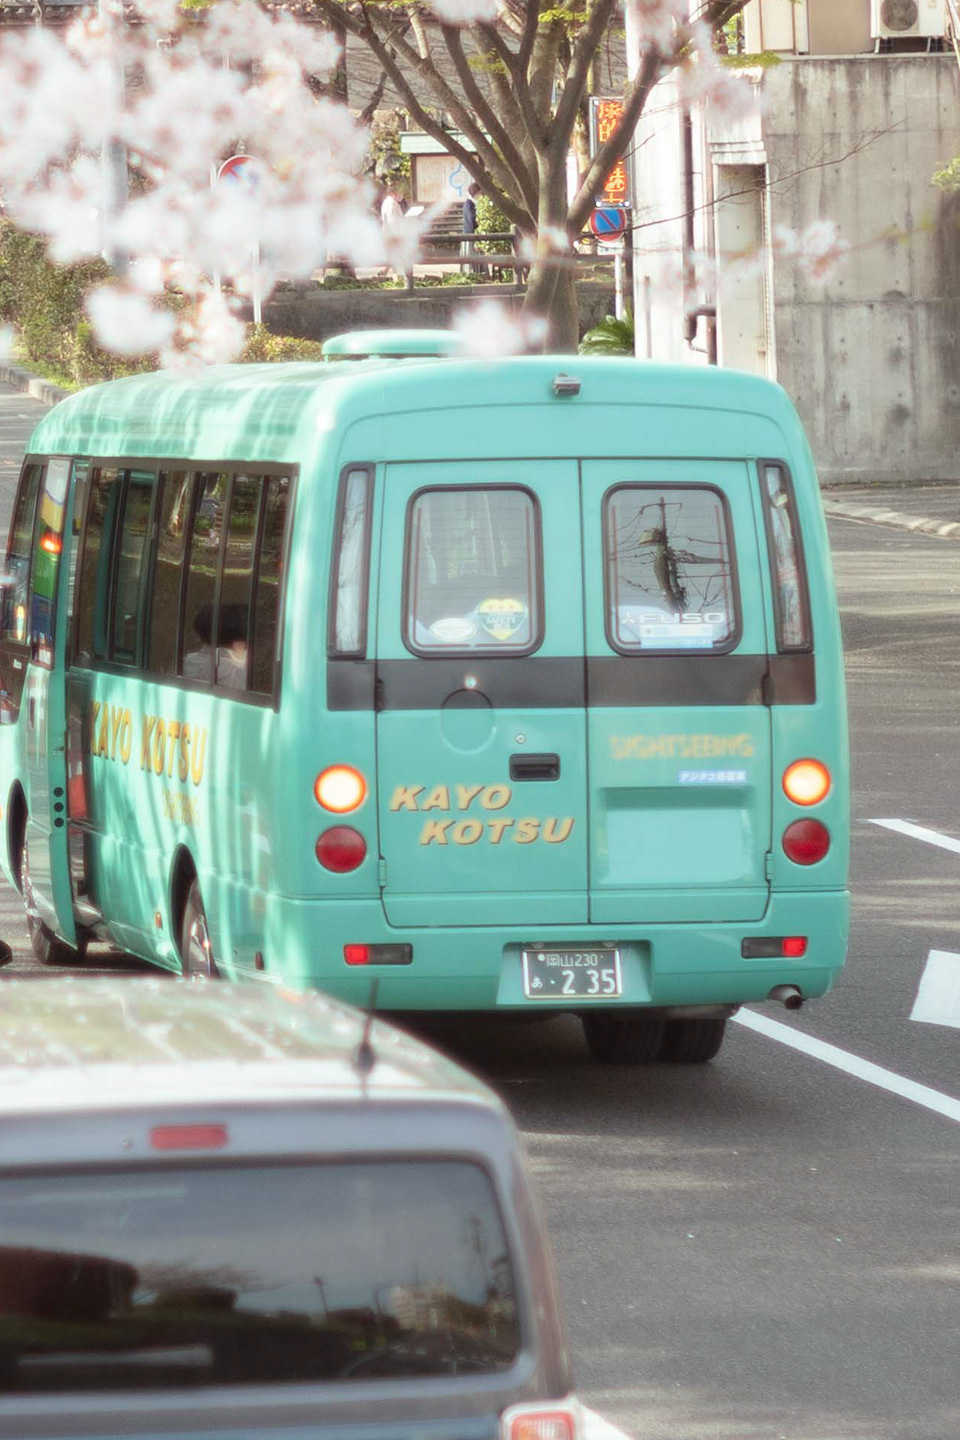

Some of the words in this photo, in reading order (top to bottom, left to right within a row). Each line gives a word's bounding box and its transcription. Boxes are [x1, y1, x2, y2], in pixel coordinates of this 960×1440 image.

[640, 612, 724, 624] FUSO
[140, 714, 207, 787] KOTSU
[390, 784, 512, 811] KAYO
[419, 817, 575, 845] KOTSU
